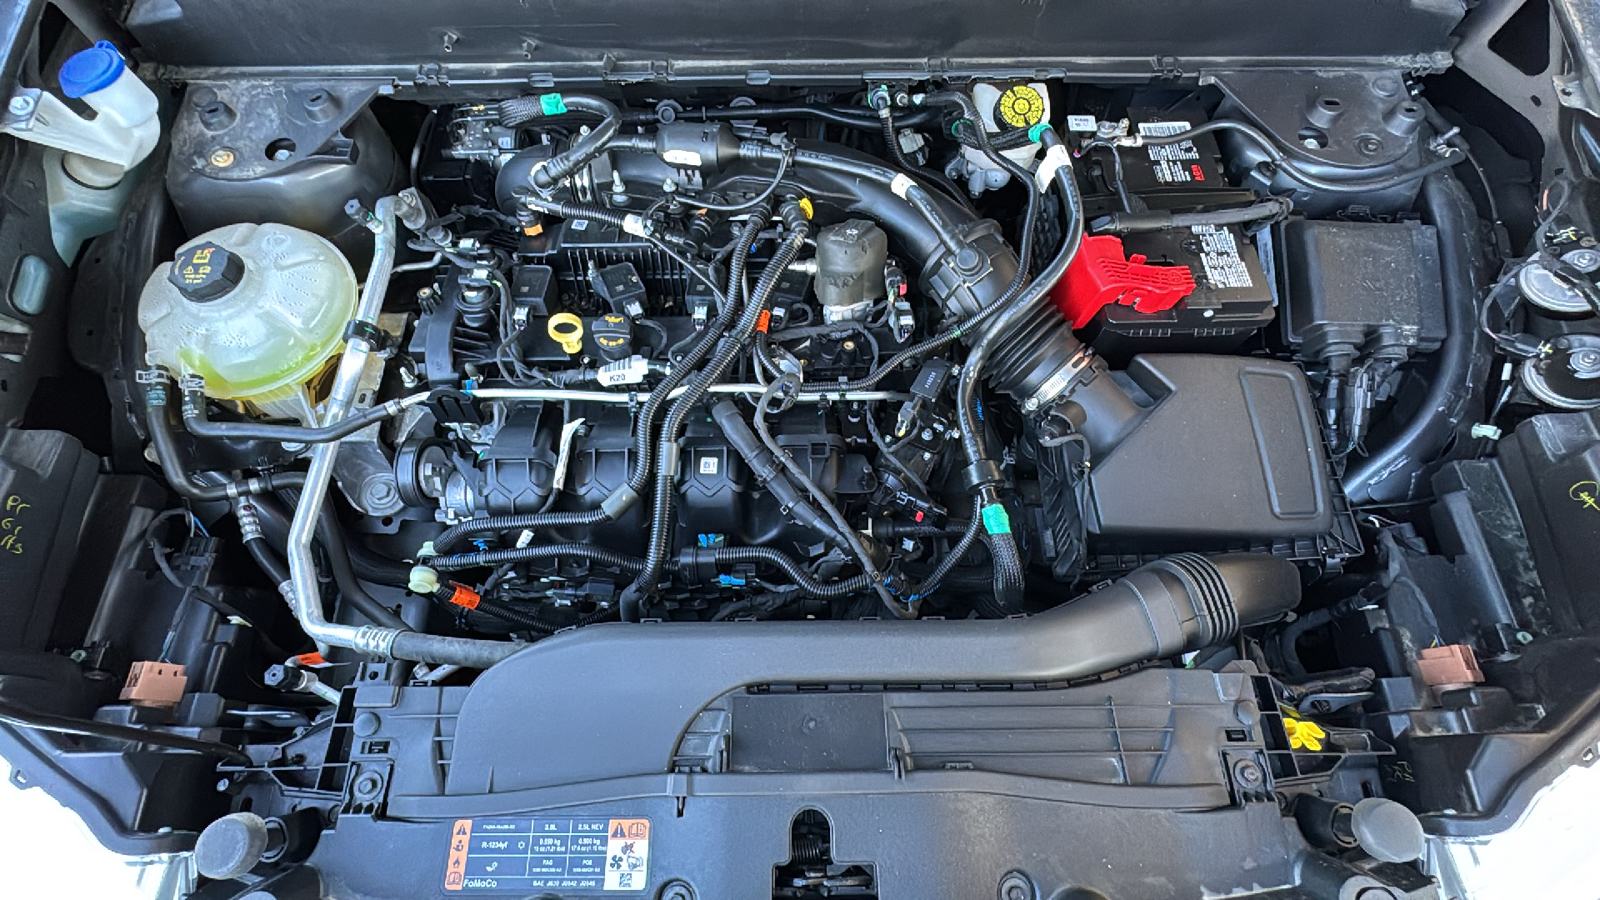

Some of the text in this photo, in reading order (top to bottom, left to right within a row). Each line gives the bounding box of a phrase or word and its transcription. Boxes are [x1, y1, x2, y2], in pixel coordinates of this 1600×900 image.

[609, 373, 626, 382] K20
[577, 823, 604, 831] 2.5L HEV
[481, 841, 509, 850] R-1234yf
[463, 879, 498, 888] FoMoCo
